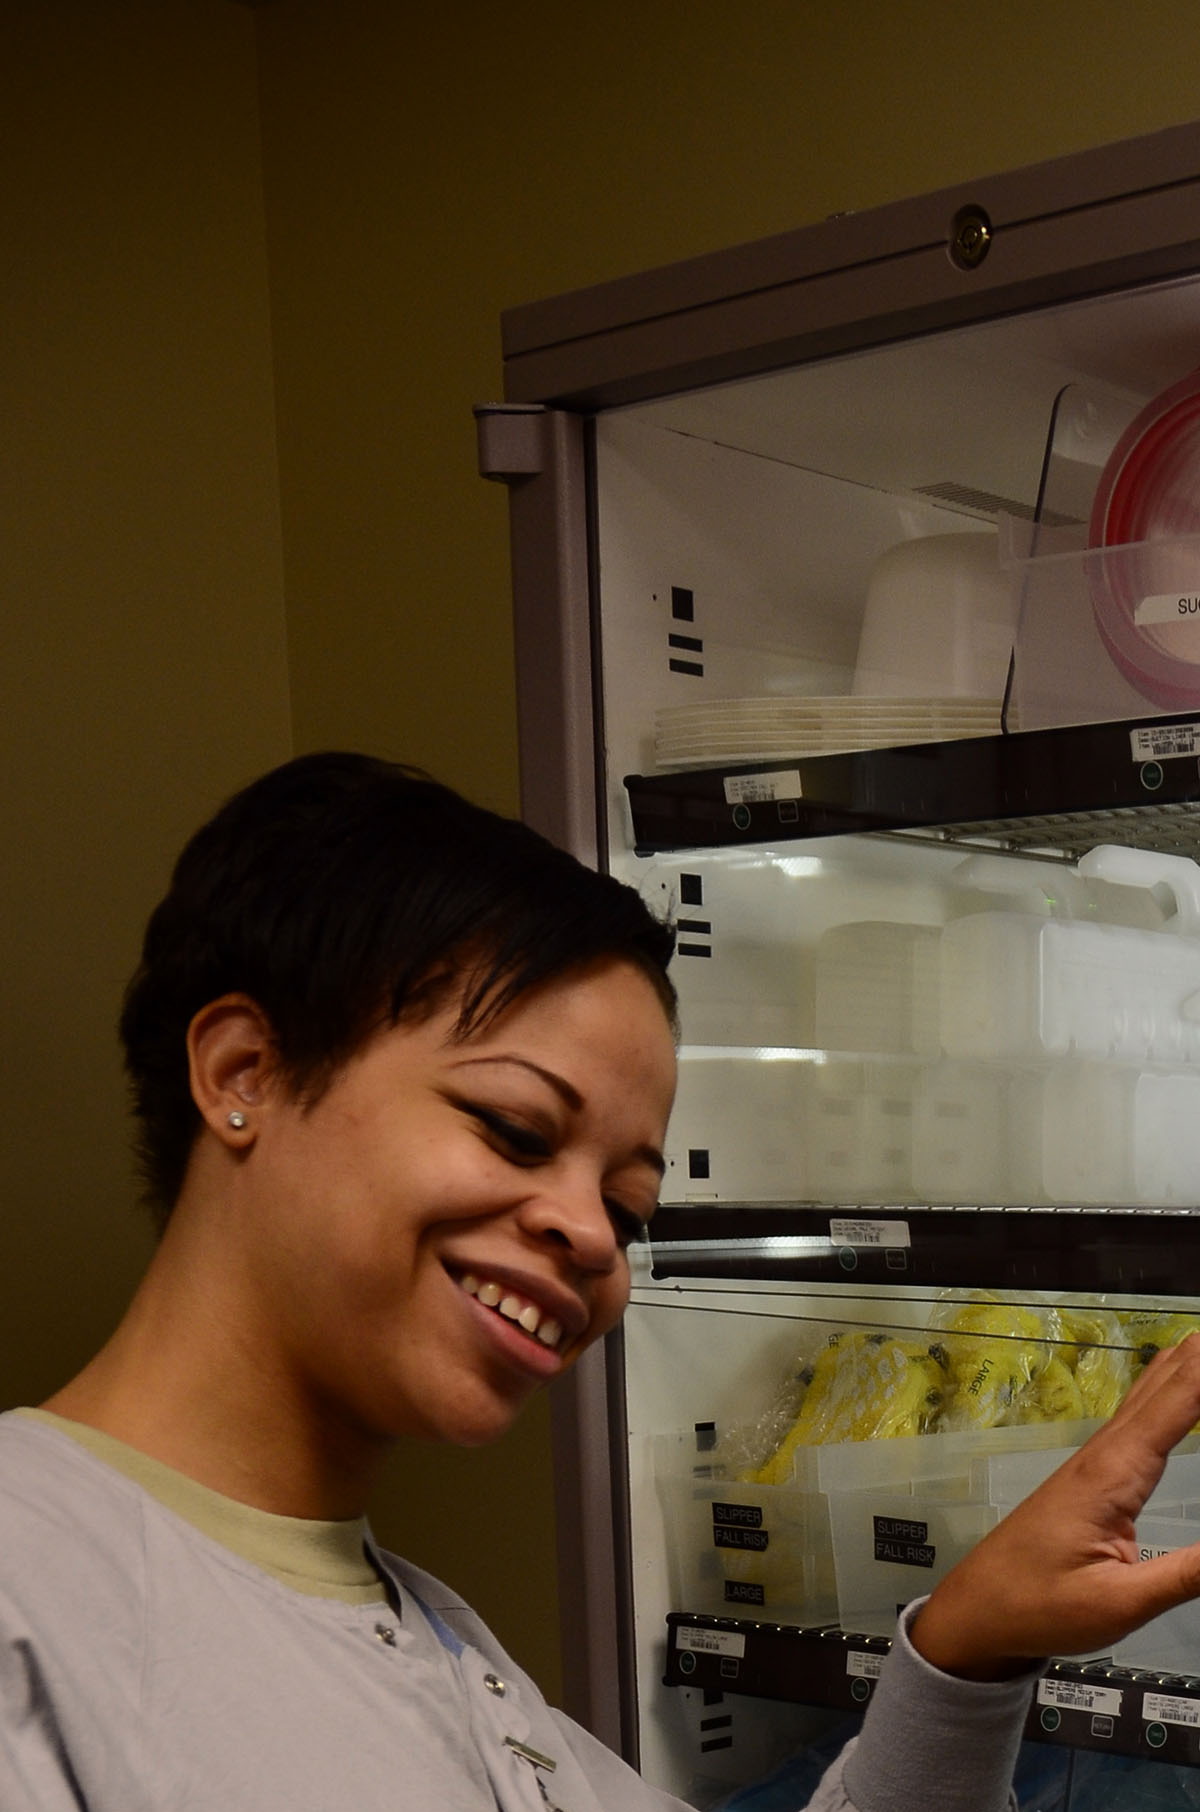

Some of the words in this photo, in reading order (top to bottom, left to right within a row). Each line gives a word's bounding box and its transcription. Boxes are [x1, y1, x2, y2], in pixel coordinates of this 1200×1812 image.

[968, 1358, 995, 1396] LARGE
[715, 1506, 761, 1524] SLIPPER
[715, 1529, 740, 1545] FALL
[743, 1532, 769, 1548] RISK
[875, 1519, 928, 1539] SLIPPER
[875, 1543, 904, 1559] FALL
[906, 1546, 934, 1562] RISK
